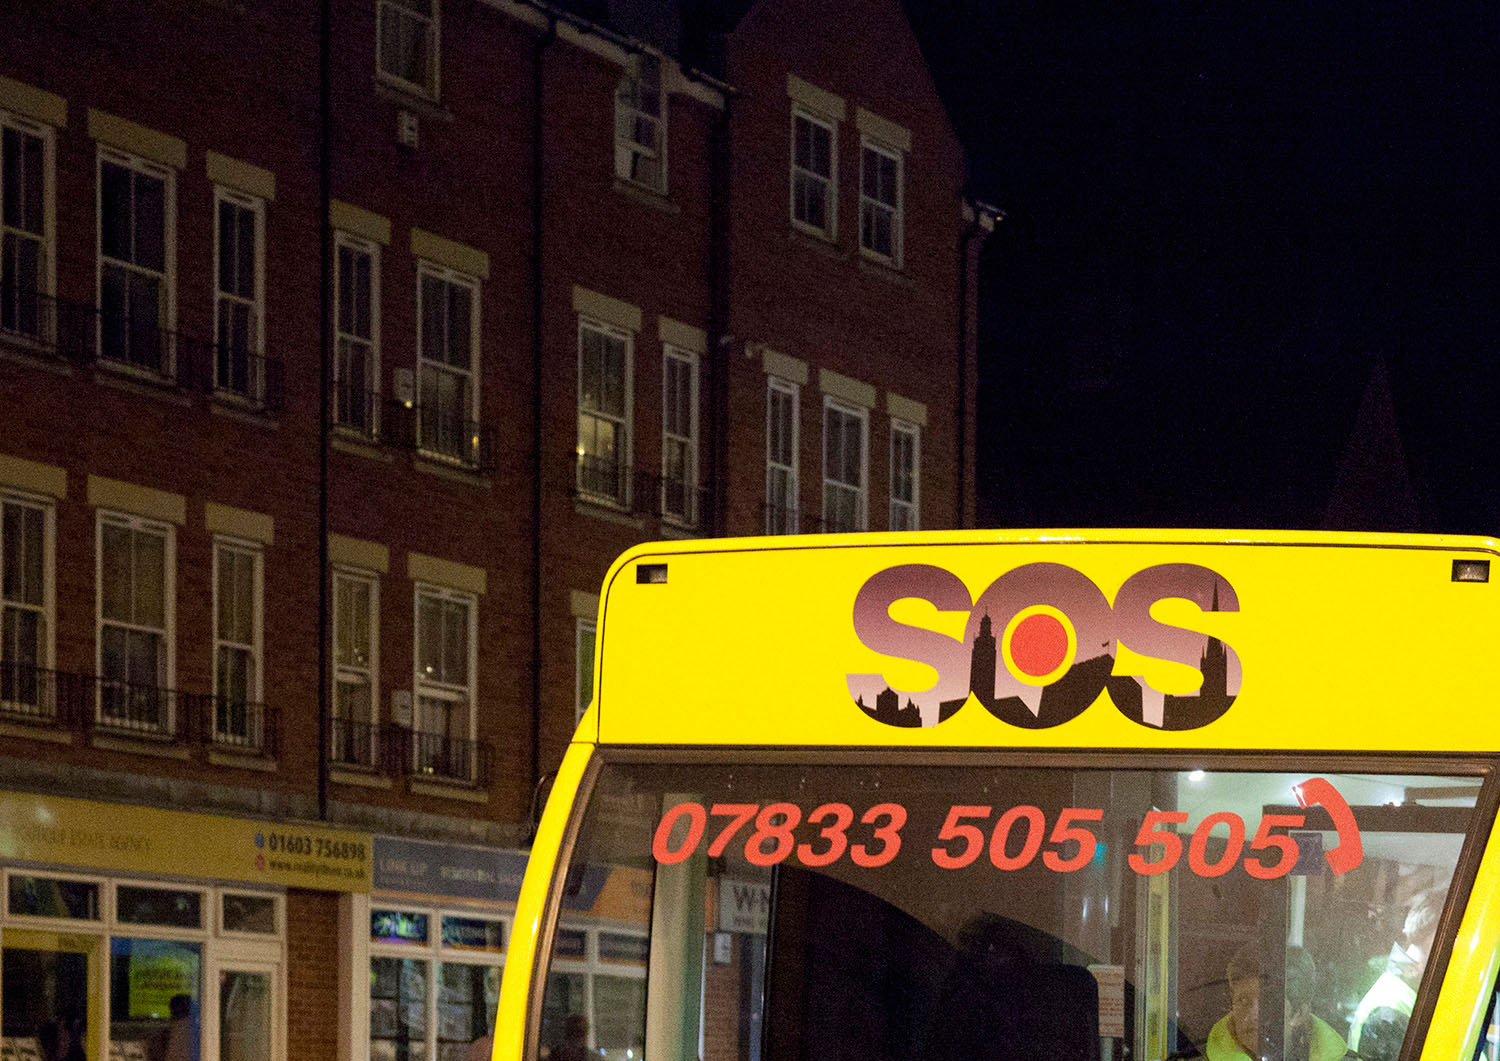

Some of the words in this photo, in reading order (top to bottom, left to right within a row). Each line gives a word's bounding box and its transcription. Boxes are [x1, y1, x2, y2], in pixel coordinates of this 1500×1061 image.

[845, 562, 1243, 731] SOS
[269, 831, 312, 856] 01603
[652, 802, 908, 866] 07833
[931, 805, 1102, 873] 505
[1127, 811, 1305, 879] 505
